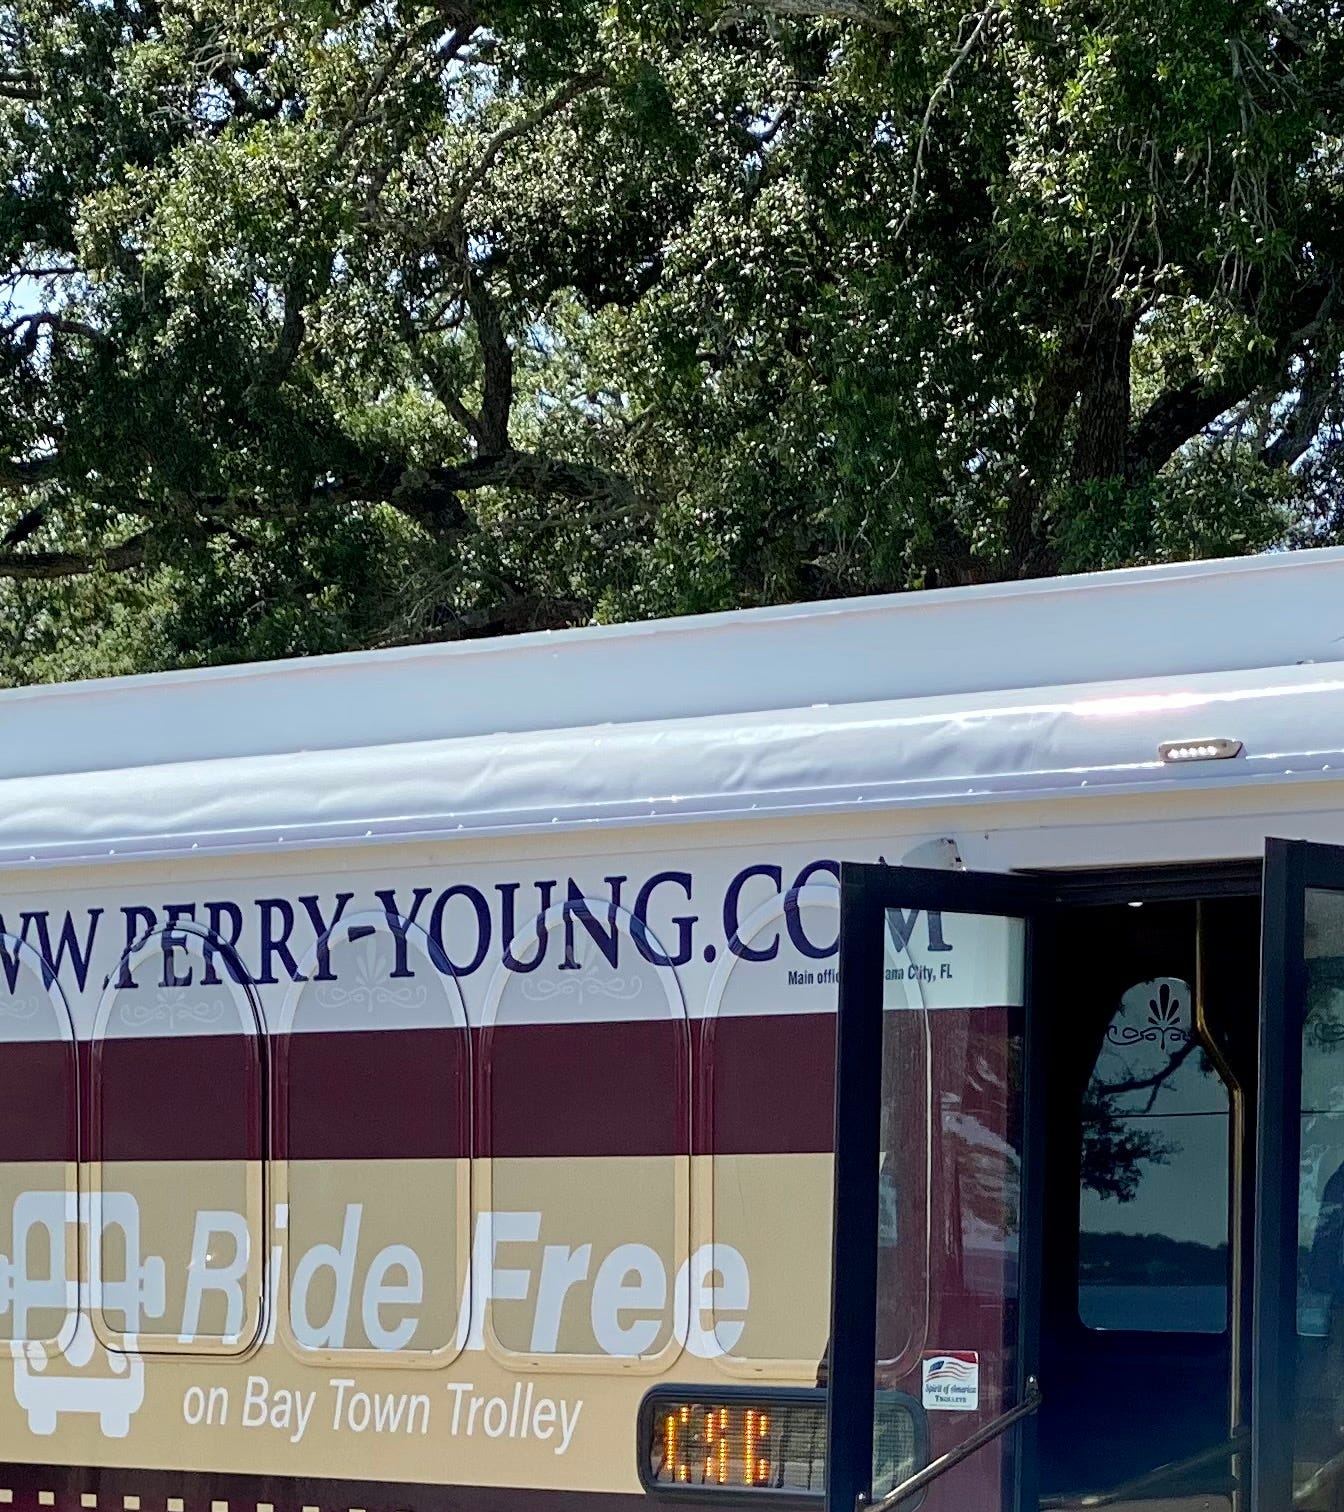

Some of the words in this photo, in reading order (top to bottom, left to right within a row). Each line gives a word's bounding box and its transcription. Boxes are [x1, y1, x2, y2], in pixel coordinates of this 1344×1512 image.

[787, 970, 814, 985] Main
[817, 968, 840, 984] offic
[940, 963, 953, 979] FL
[177, 1203, 424, 1350] Ride
[455, 1211, 751, 1359] Free
[183, 1384, 229, 1426] on
[241, 1375, 316, 1444] Bay
[329, 1378, 431, 1435] Town
[446, 1381, 583, 1455] Trolley
